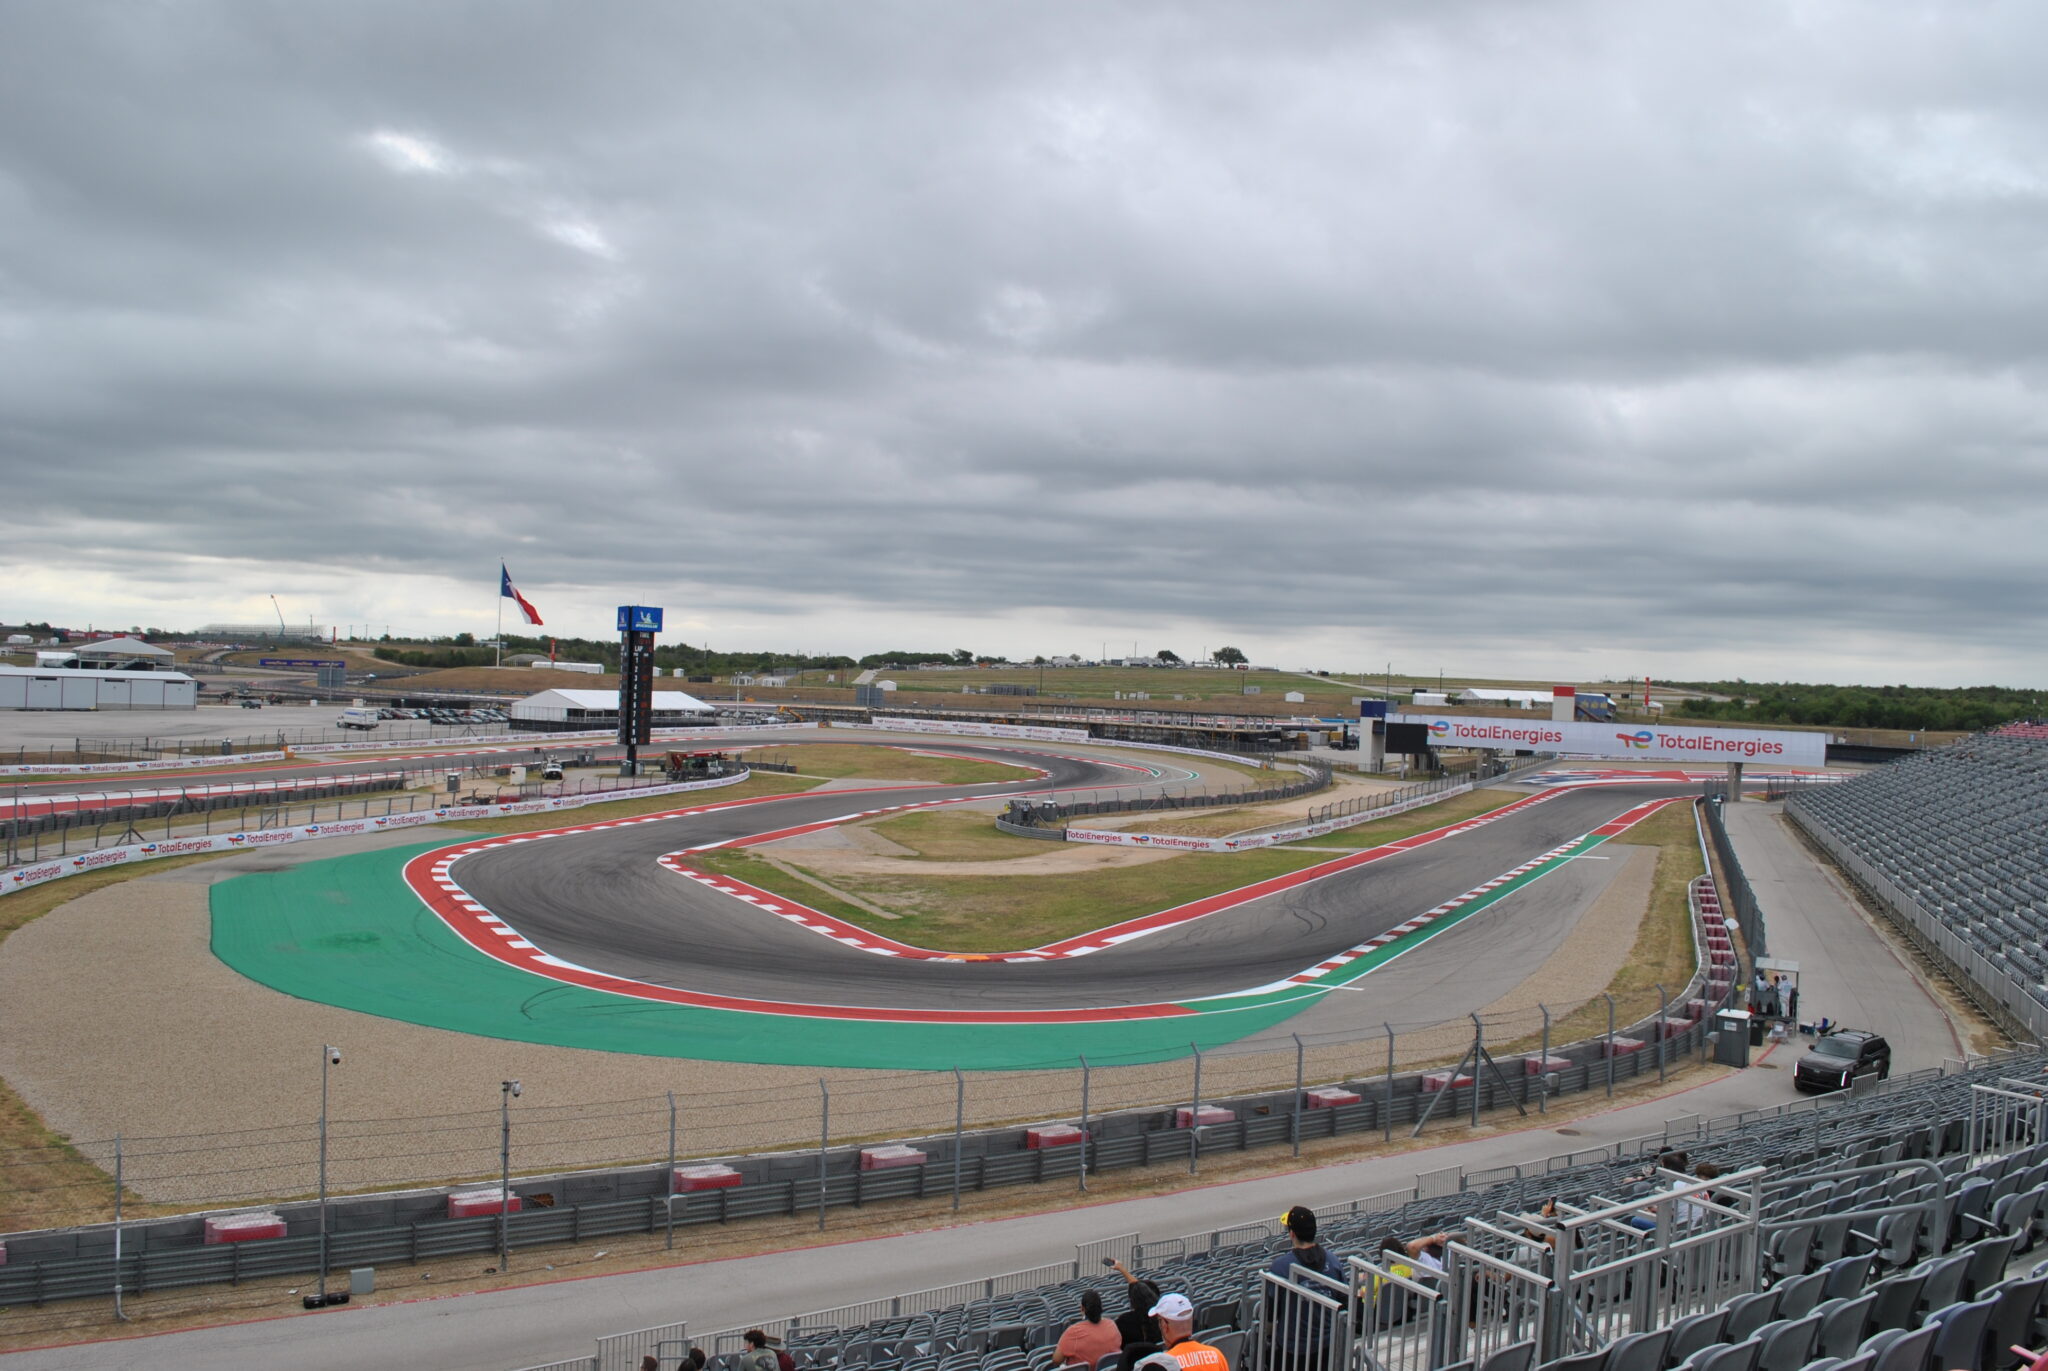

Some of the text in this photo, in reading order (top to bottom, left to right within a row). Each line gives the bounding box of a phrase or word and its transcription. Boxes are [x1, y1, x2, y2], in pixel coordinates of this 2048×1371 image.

[1453, 723, 1562, 745] TotalEnergies
[1657, 733, 1782, 756] TotalEnergies
[448, 808, 488, 818] TotalEnergies
[513, 803, 546, 812] TotalEnergies
[388, 814, 426, 827] TotalEnergies
[320, 822, 364, 835] TotalEnergies
[247, 831, 293, 846] TotalEnergies
[1067, 830, 1122, 843] TotalEnergies
[1152, 836, 1210, 849] TotalEnergies
[158, 838, 212, 854] TotalEnergies
[86, 850, 127, 866] TotalEnergies
[25, 864, 62, 882] TotalEnergies
[1177, 1350, 1218, 1368] OLUNTEER
